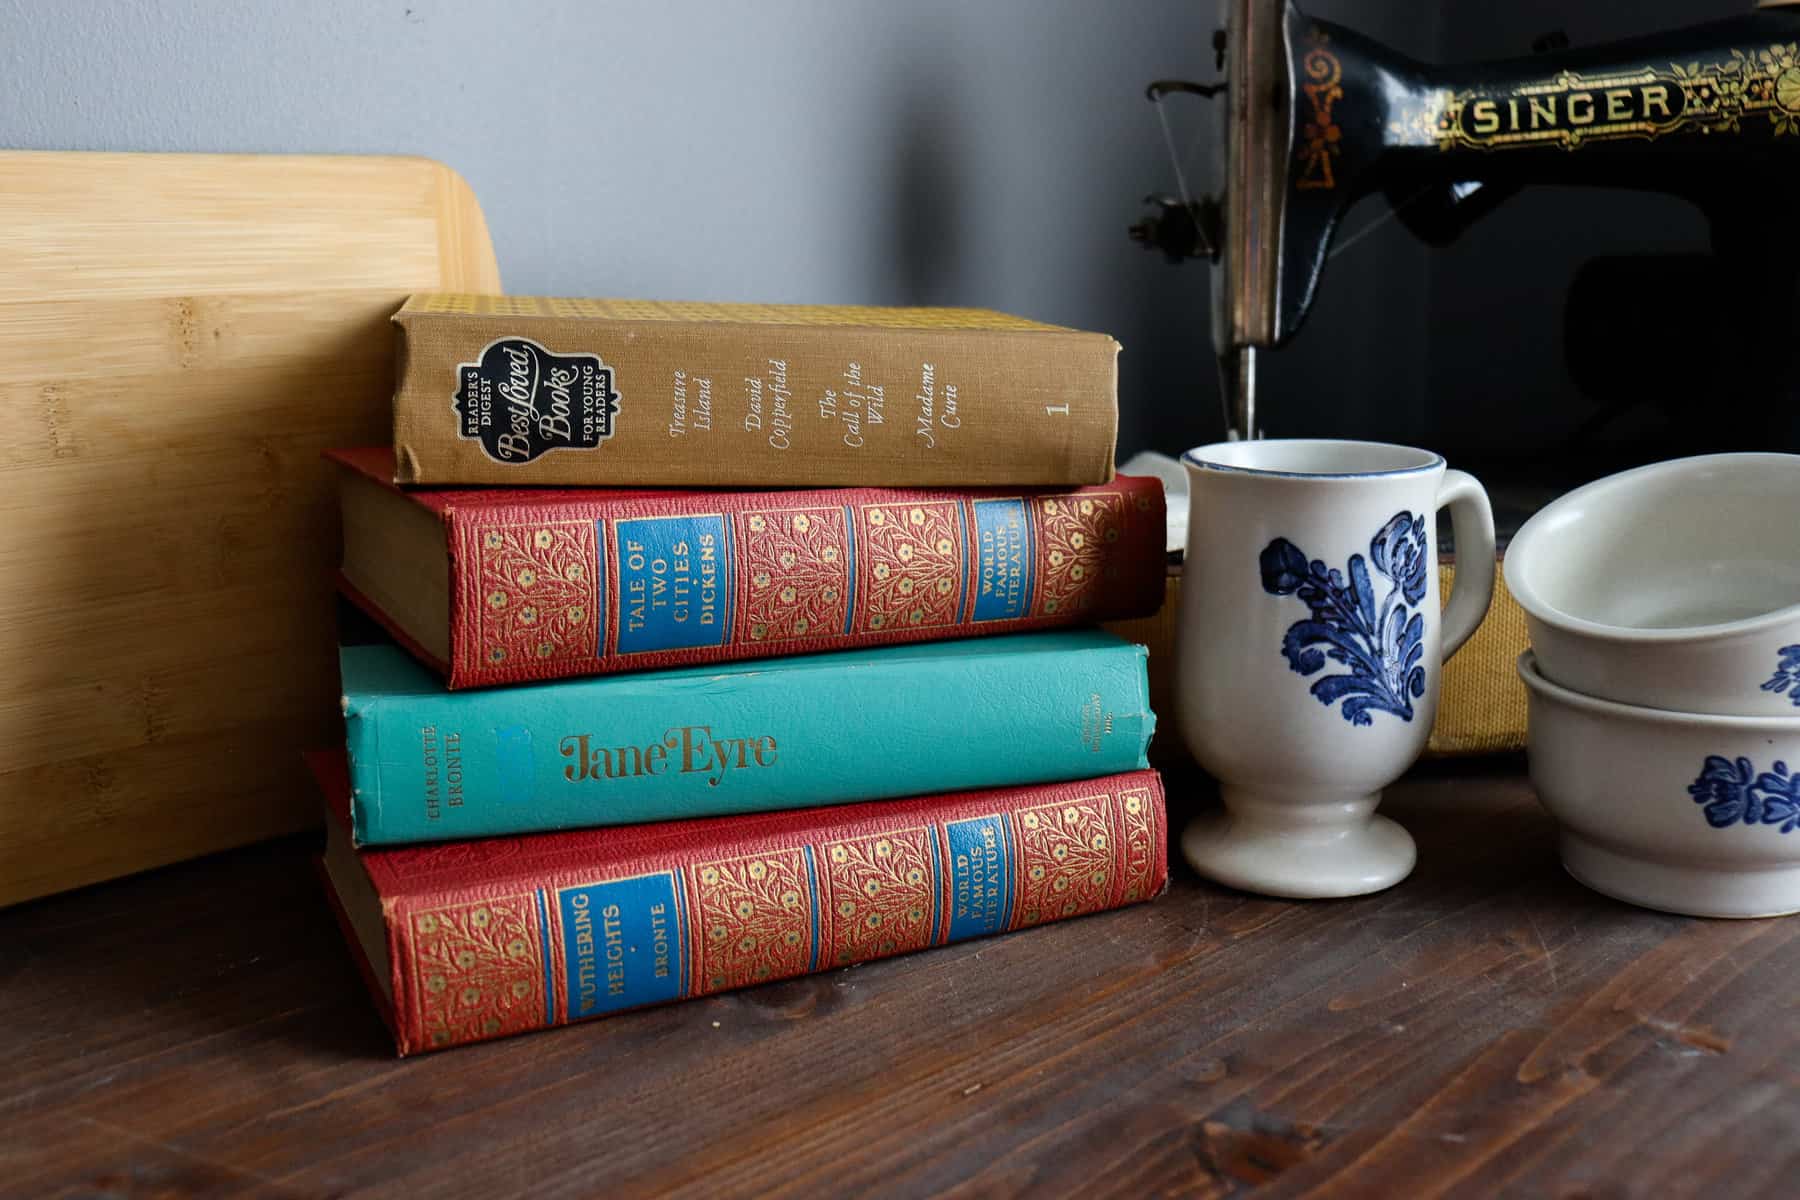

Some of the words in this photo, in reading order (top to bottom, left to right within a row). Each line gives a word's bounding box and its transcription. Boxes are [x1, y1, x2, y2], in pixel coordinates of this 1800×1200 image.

[1472, 85, 1672, 133] SINGER
[467, 371, 479, 435] READER'S
[480, 377, 491, 426] DIGEST
[498, 344, 540, 422] Loved
[538, 364, 579, 441] Books
[583, 365, 593, 415] YOUNG
[595, 374, 606, 432] READERS
[669, 368, 687, 438] Treasure
[693, 376, 712, 431] Island
[744, 376, 762, 432] David
[768, 359, 792, 450] Copperfield
[820, 389, 836, 419] The
[843, 362, 860, 386] the
[847, 390, 866, 409] of
[867, 385, 885, 424] Wild
[916, 362, 935, 449] Madame
[498, 406, 530, 459] Best
[583, 416, 593, 441] FOR
[843, 411, 864, 448] Call
[940, 383, 961, 430] Curie
[1046, 402, 1069, 418] 1
[628, 540, 646, 571] OF
[652, 558, 668, 611] TWO
[673, 541, 689, 623] CITIES
[701, 533, 716, 625] DICKENS
[982, 530, 995, 596] WORLD
[995, 526, 1008, 598] FAMOUS
[1006, 507, 1022, 613] LITERATURE
[629, 578, 646, 632] TALE
[422, 725, 440, 820] CHARLOTTE
[444, 732, 464, 808] BRONTE
[559, 733, 667, 784] Jane
[665, 725, 778, 787] Eyre
[957, 854, 971, 919] WORLD
[971, 846, 985, 920] FAMOUS
[983, 824, 999, 931] LITERATURE
[572, 893, 596, 1012] WUTHERING
[603, 904, 625, 996] HEIGHTS
[651, 902, 670, 978] BRONTE
